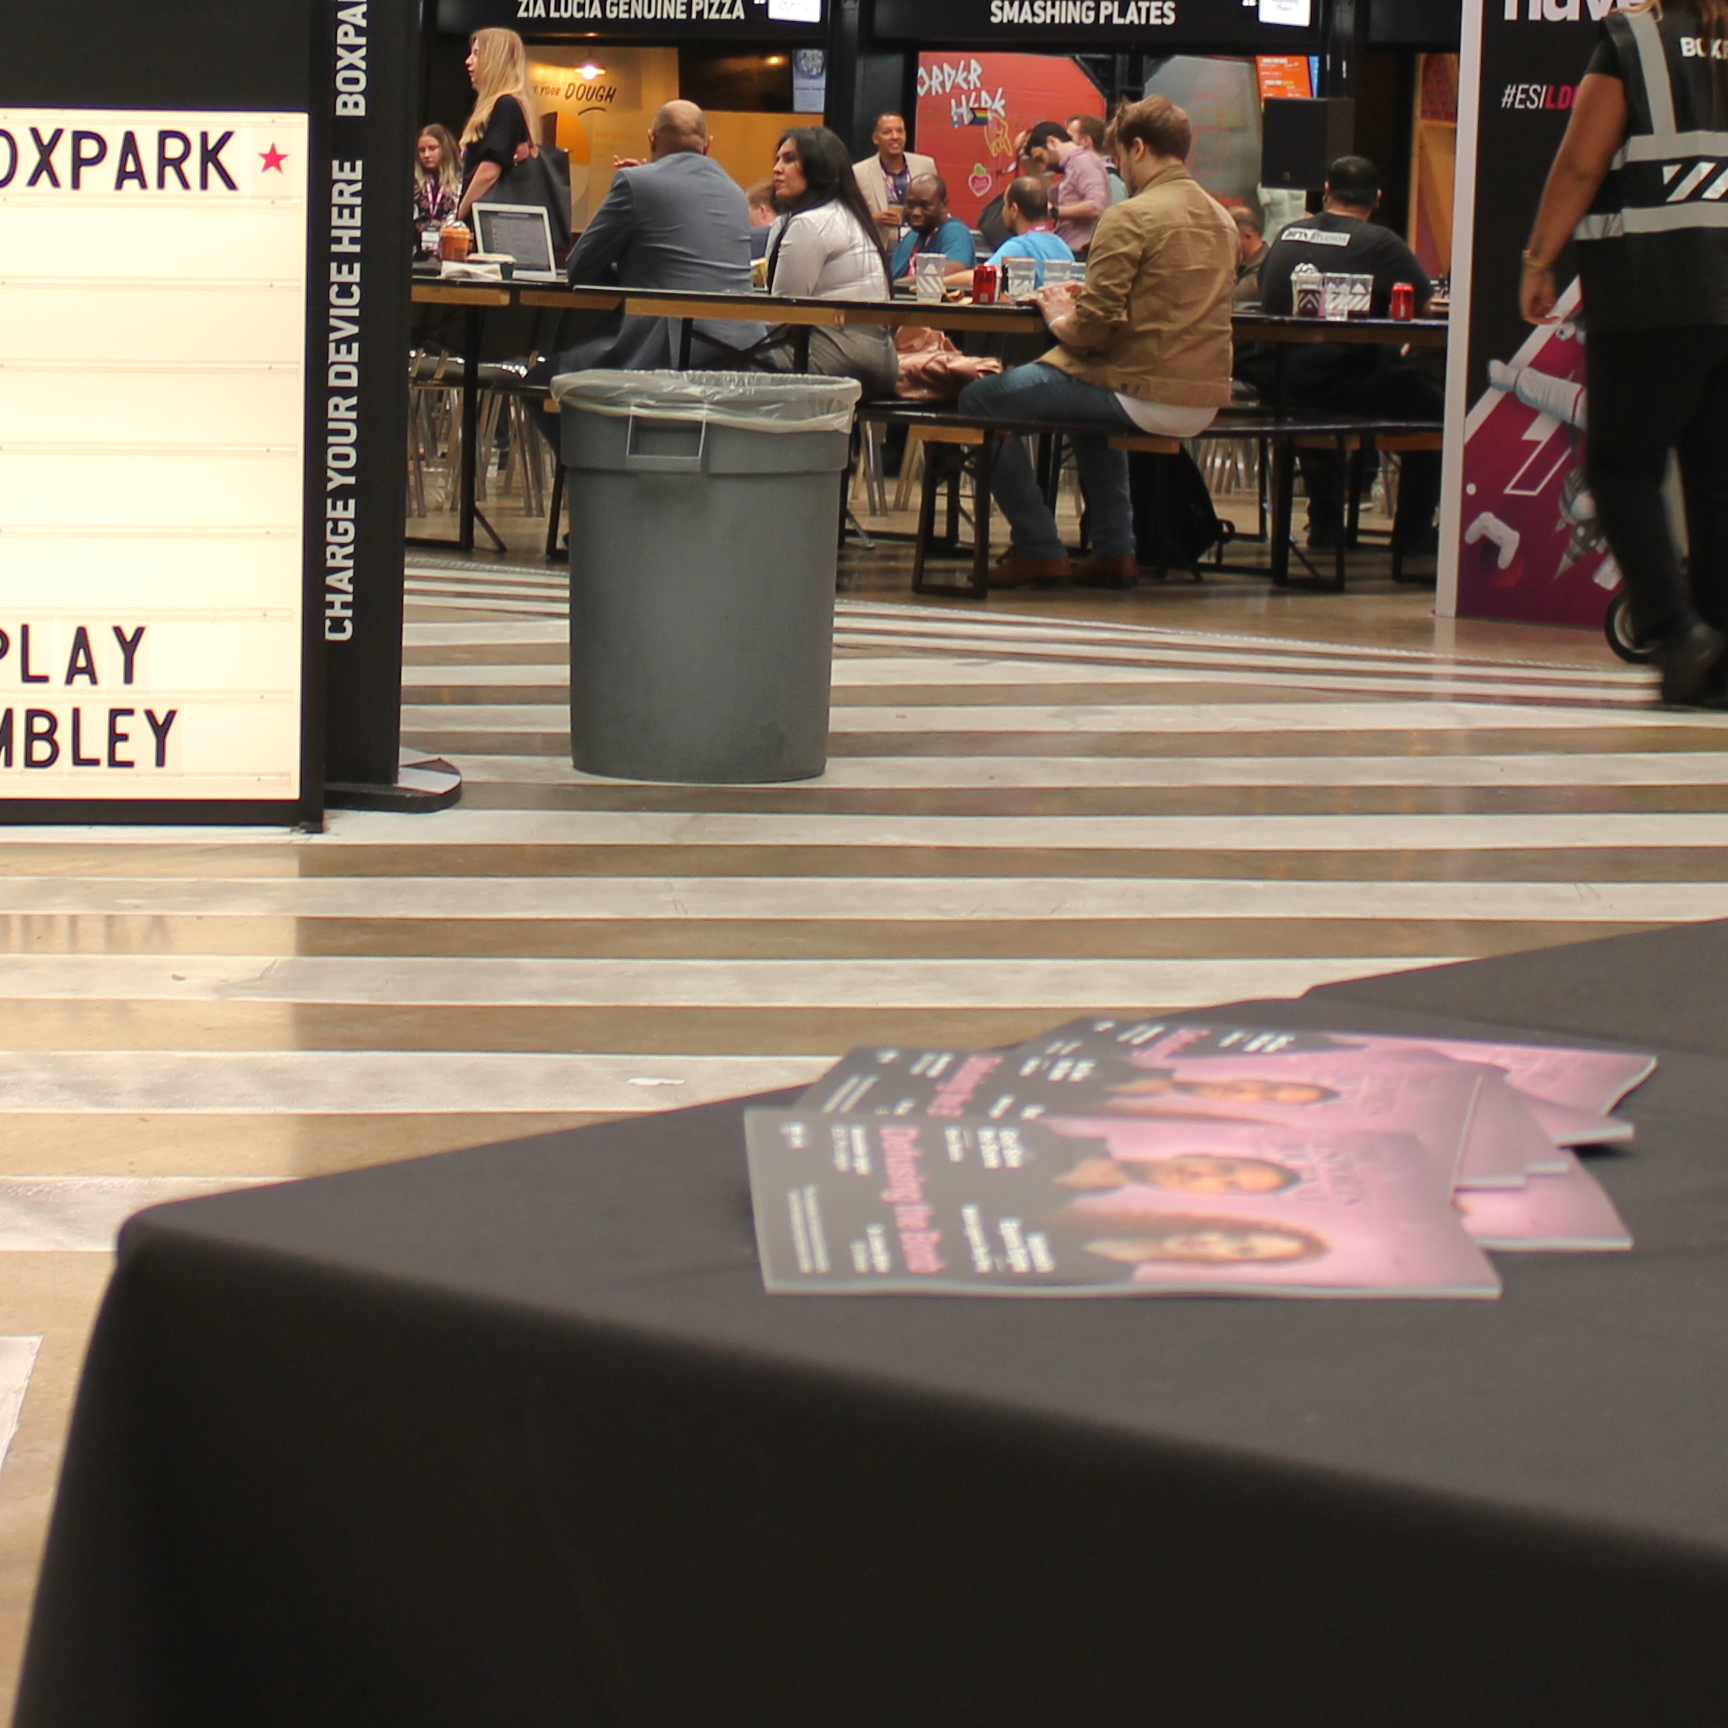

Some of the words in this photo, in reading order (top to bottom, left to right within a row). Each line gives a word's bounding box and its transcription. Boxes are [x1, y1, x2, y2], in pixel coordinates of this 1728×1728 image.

[990, 0, 1095, 25] SMASHING
[1099, 1, 1176, 25] PLATES
[564, 82, 617, 103] DOUGH
[917, 58, 983, 97] ORDER
[330, 159, 363, 253] HERE
[327, 262, 361, 387] DEVICE
[327, 395, 357, 491] YOUR
[325, 498, 355, 642] CHARGE
